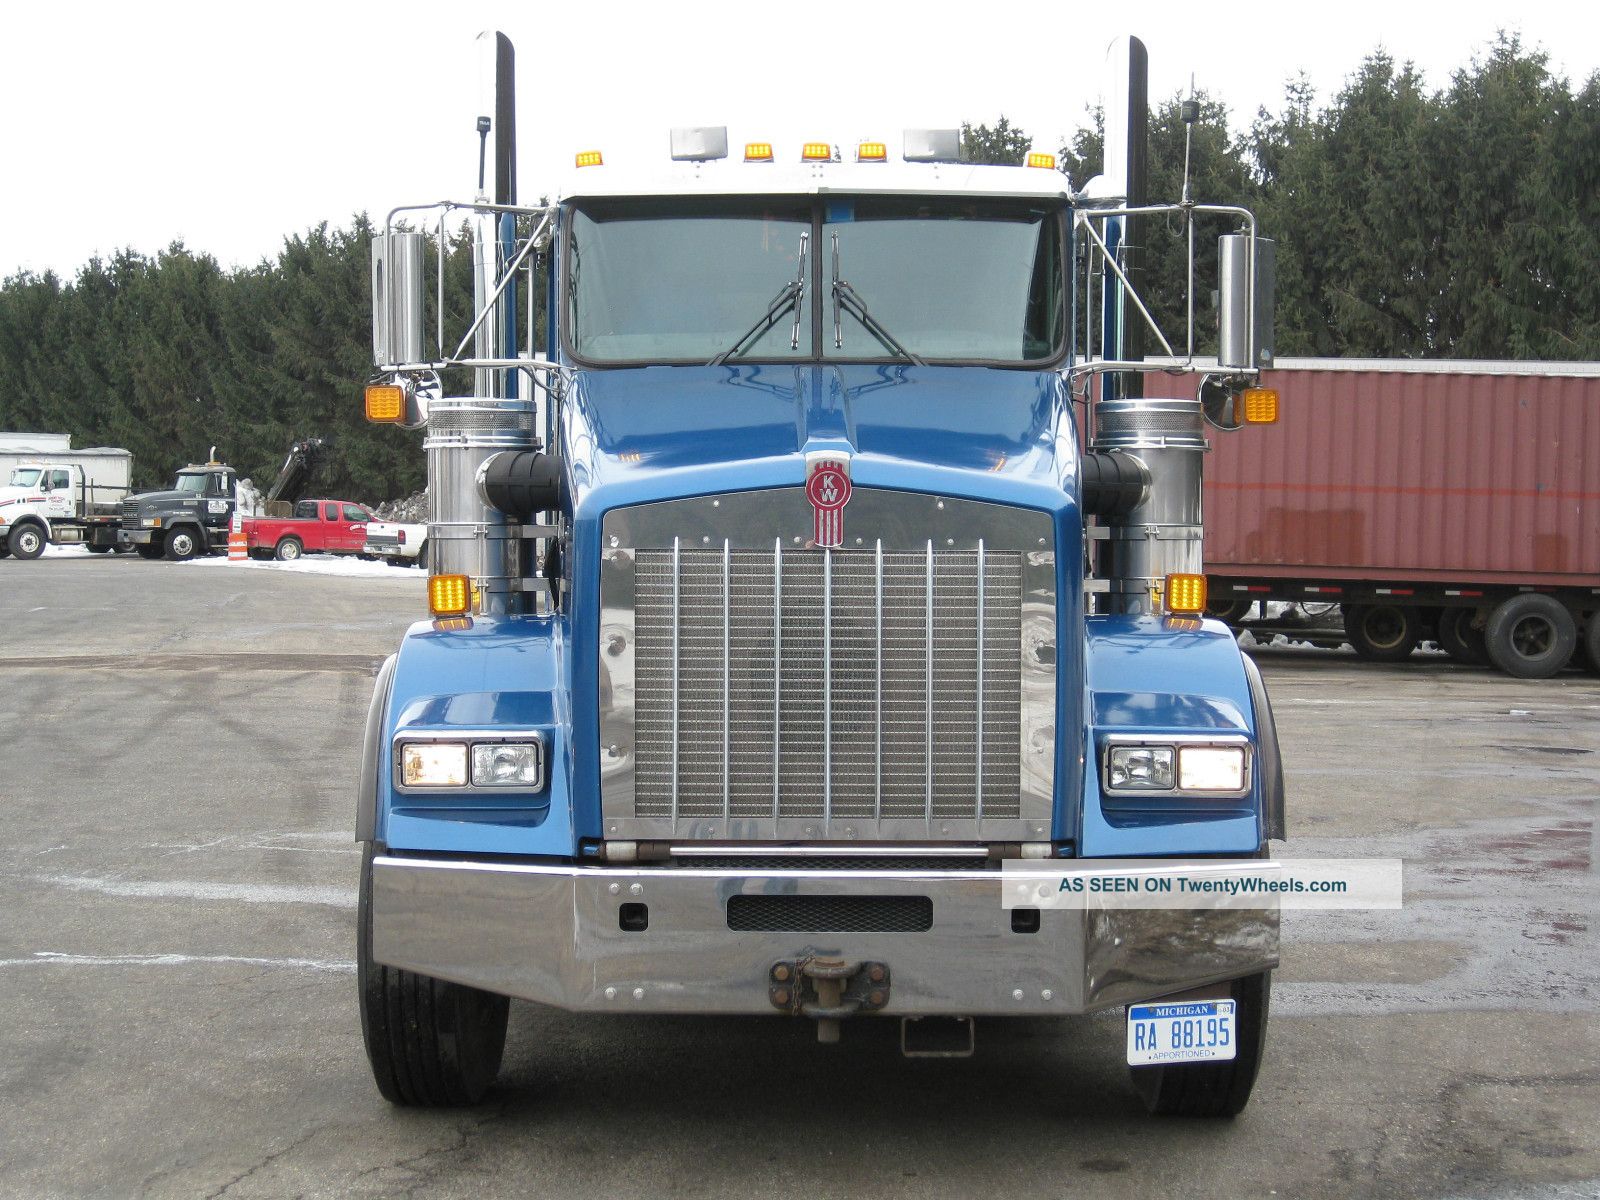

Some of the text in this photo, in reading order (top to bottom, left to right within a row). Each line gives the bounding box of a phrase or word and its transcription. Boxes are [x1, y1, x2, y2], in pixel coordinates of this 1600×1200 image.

[1155, 1005, 1209, 1017] MICHIGAN
[1135, 1018, 1230, 1051] RA 88195
[1152, 1049, 1211, 1060] APPORTIONED
